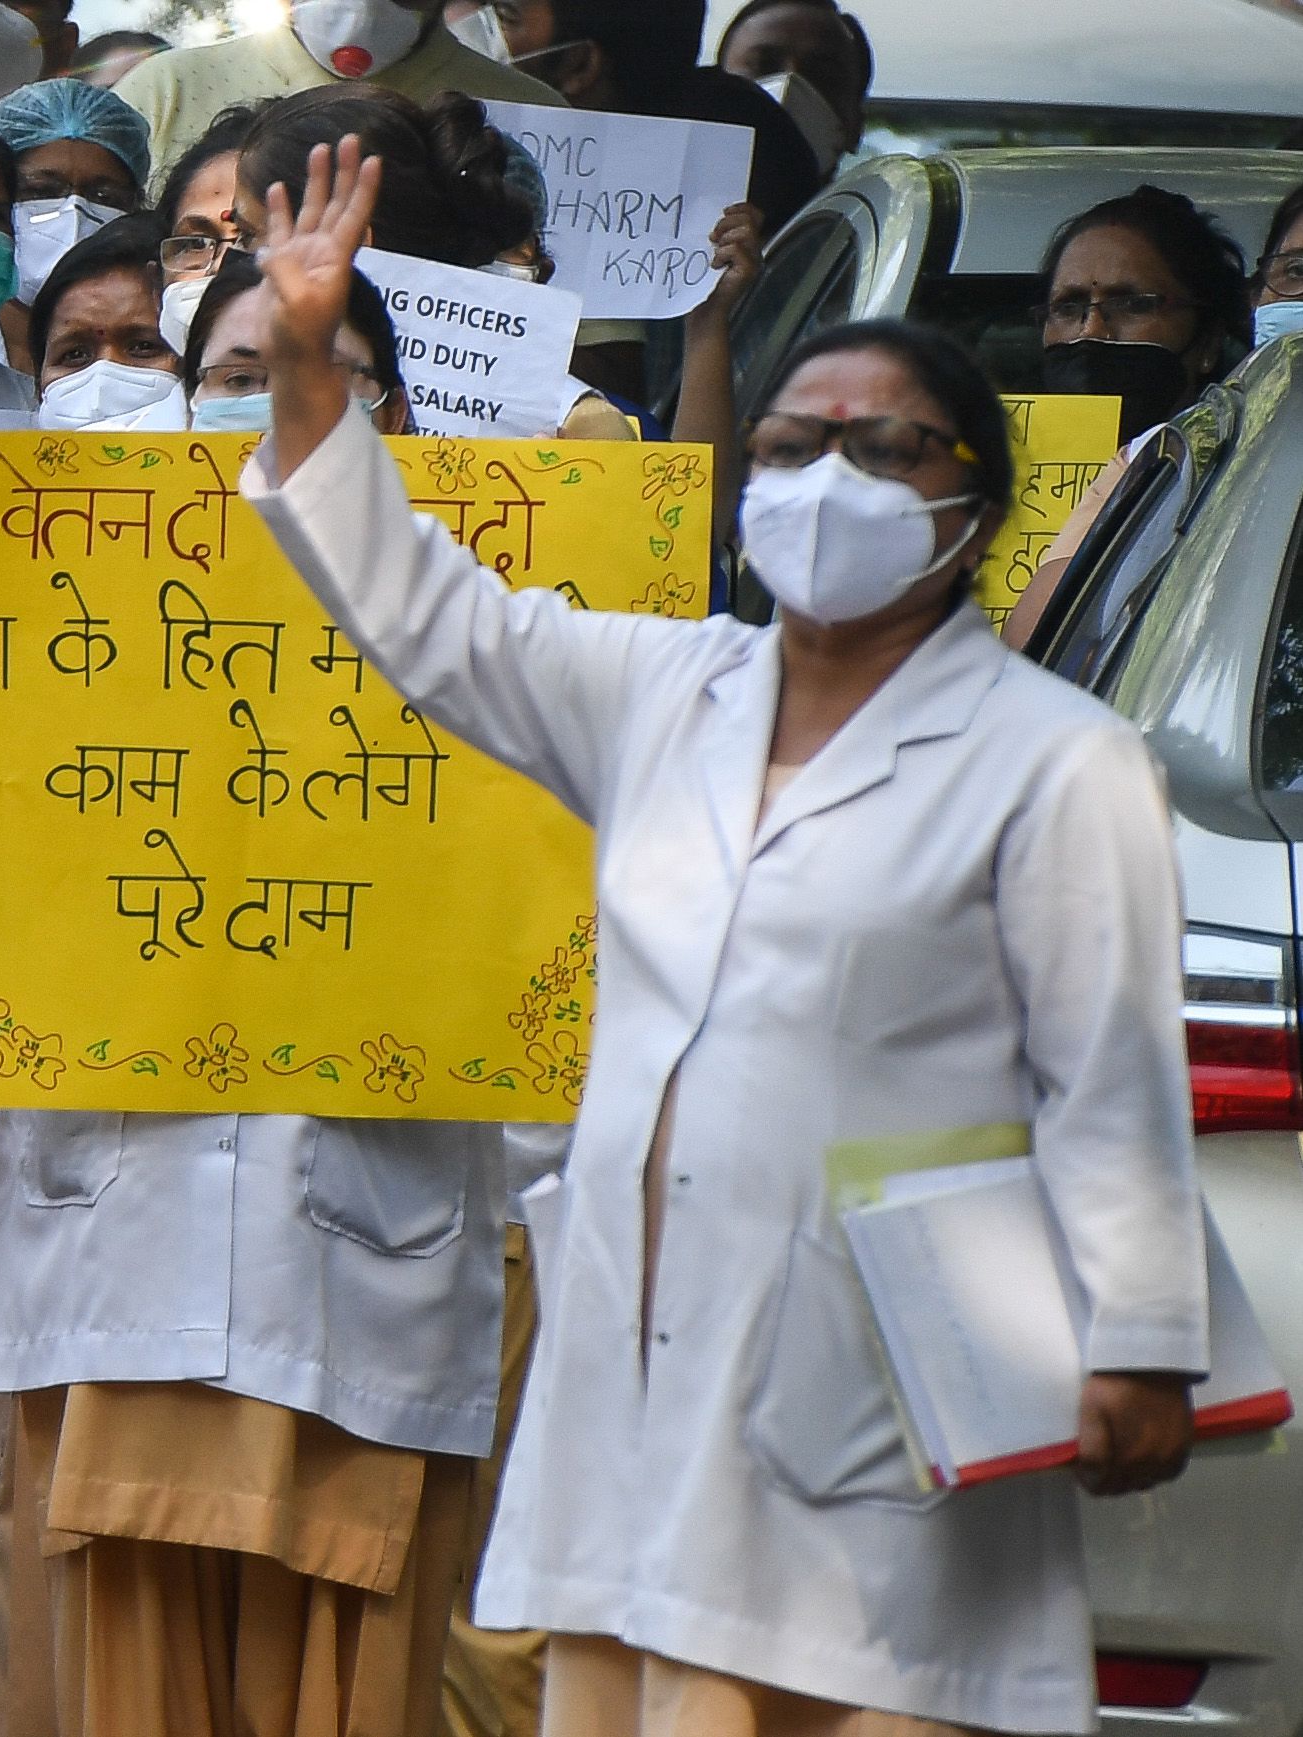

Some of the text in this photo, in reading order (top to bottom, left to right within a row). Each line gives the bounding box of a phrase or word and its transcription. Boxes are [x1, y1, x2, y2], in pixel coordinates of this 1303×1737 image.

[602, 248, 709, 299] KARO
[416, 295, 527, 338] OFFICERS
[433, 343, 498, 377] DUTY
[411, 384, 503, 422] SALARY
[47, 572, 118, 688] के
[159, 579, 286, 694] हित
[44, 744, 190, 818] काम
[227, 699, 290, 818] के
[105, 828, 373, 962] पूरे दाम
